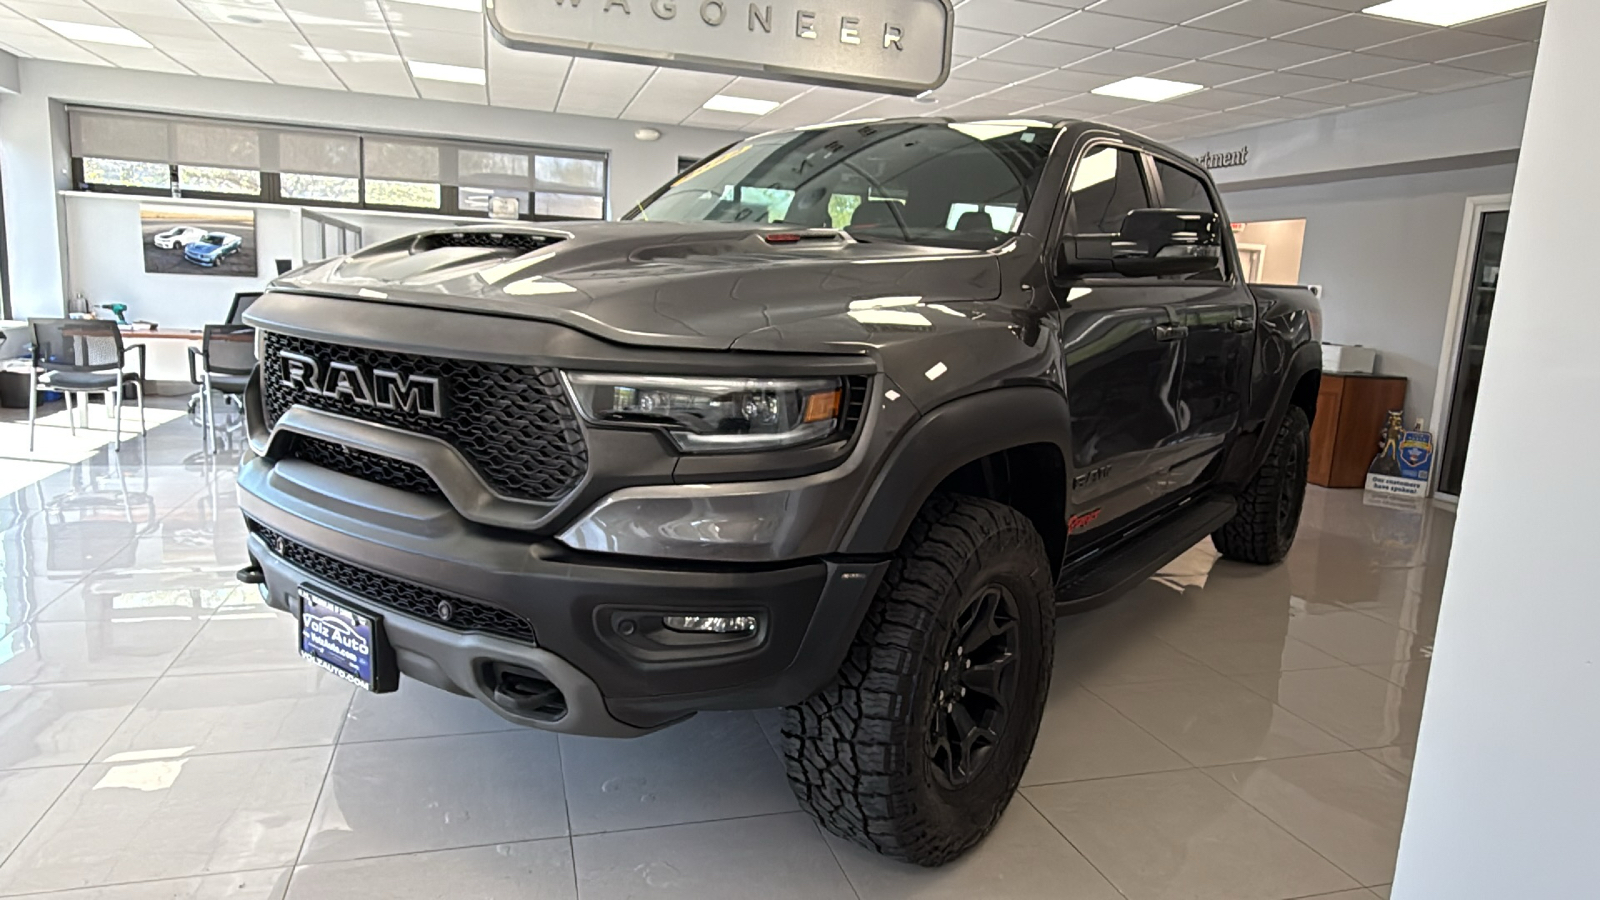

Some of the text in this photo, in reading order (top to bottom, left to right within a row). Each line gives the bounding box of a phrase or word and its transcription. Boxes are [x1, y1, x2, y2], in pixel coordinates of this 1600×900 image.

[555, 0, 904, 51] AGONEER
[1197, 145, 1248, 169] rtment
[280, 350, 441, 417] RAM
[303, 613, 329, 637] Volz
[331, 627, 369, 655] Auto
